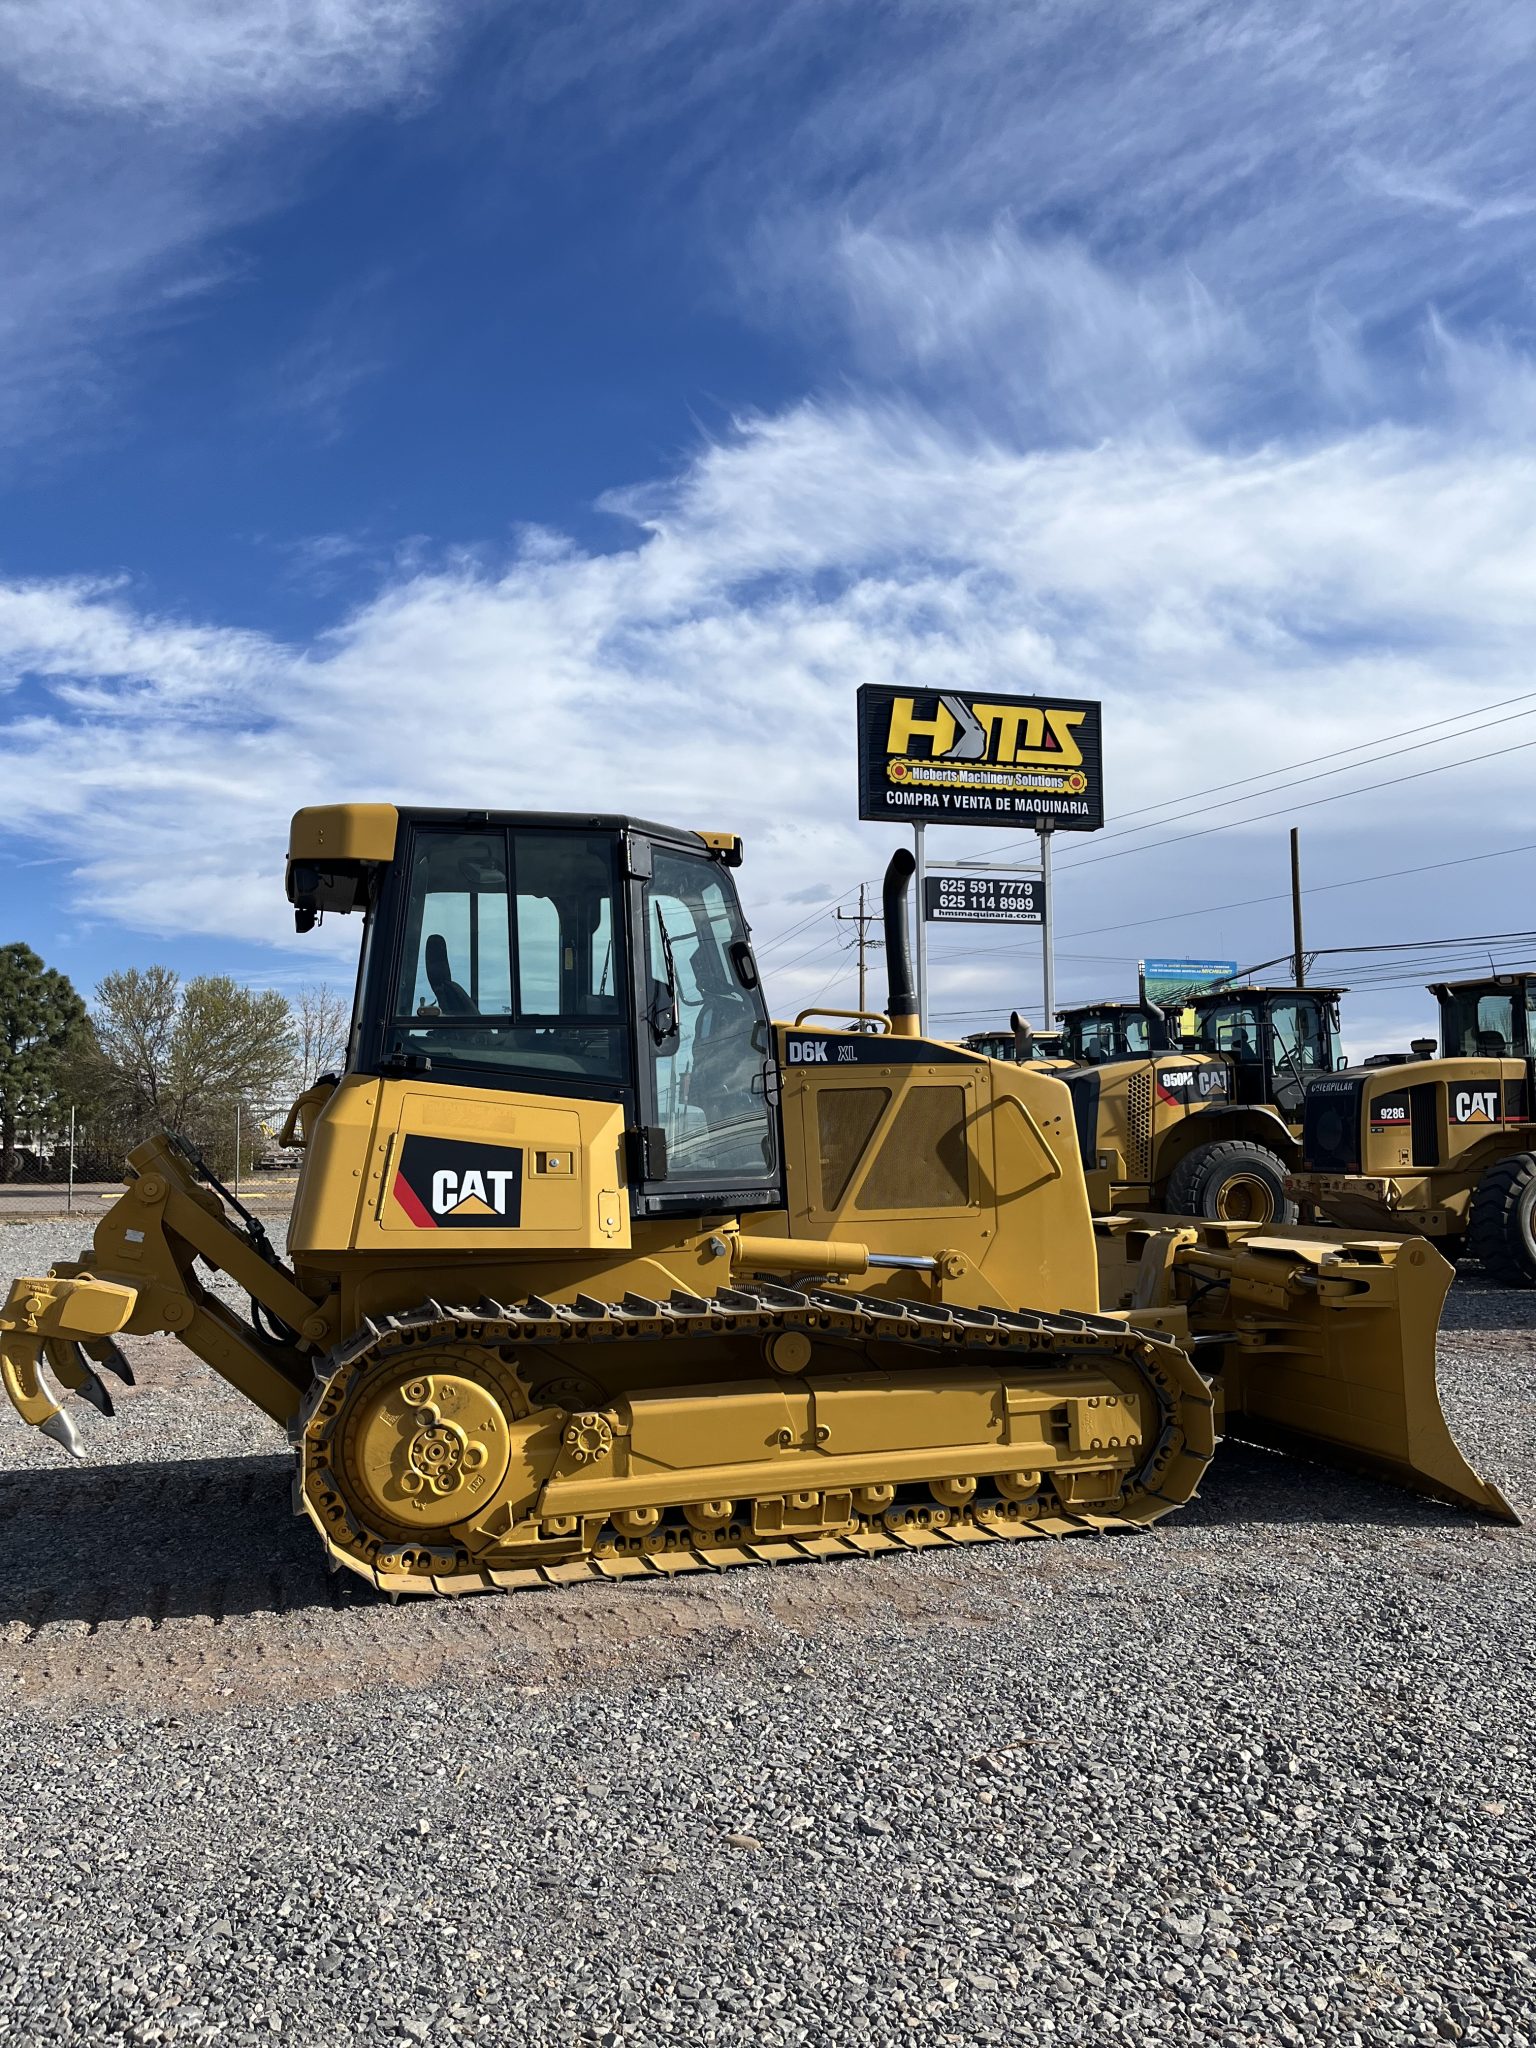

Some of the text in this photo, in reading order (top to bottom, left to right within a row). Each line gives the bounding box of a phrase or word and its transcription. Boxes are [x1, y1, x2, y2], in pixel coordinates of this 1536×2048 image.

[912, 767, 1064, 788] Hieberts Machinery Solutions
[886, 791, 1089, 815] COMPRA Y VENTA DE MAQUINARIA
[940, 880, 1033, 895] 625 591 7779
[940, 895, 1033, 910] 625 114 8989
[938, 910, 1036, 919] hmsmaquinaria.com
[789, 1041, 858, 1062] D6K XL
[1162, 1071, 1193, 1087] 950M
[1198, 1070, 1227, 1096] CAT
[1311, 1081, 1353, 1092] CATERPILLAR
[1380, 1107, 1405, 1119] 928G
[1455, 1092, 1497, 1122] CAT
[432, 1169, 513, 1215] CAT
